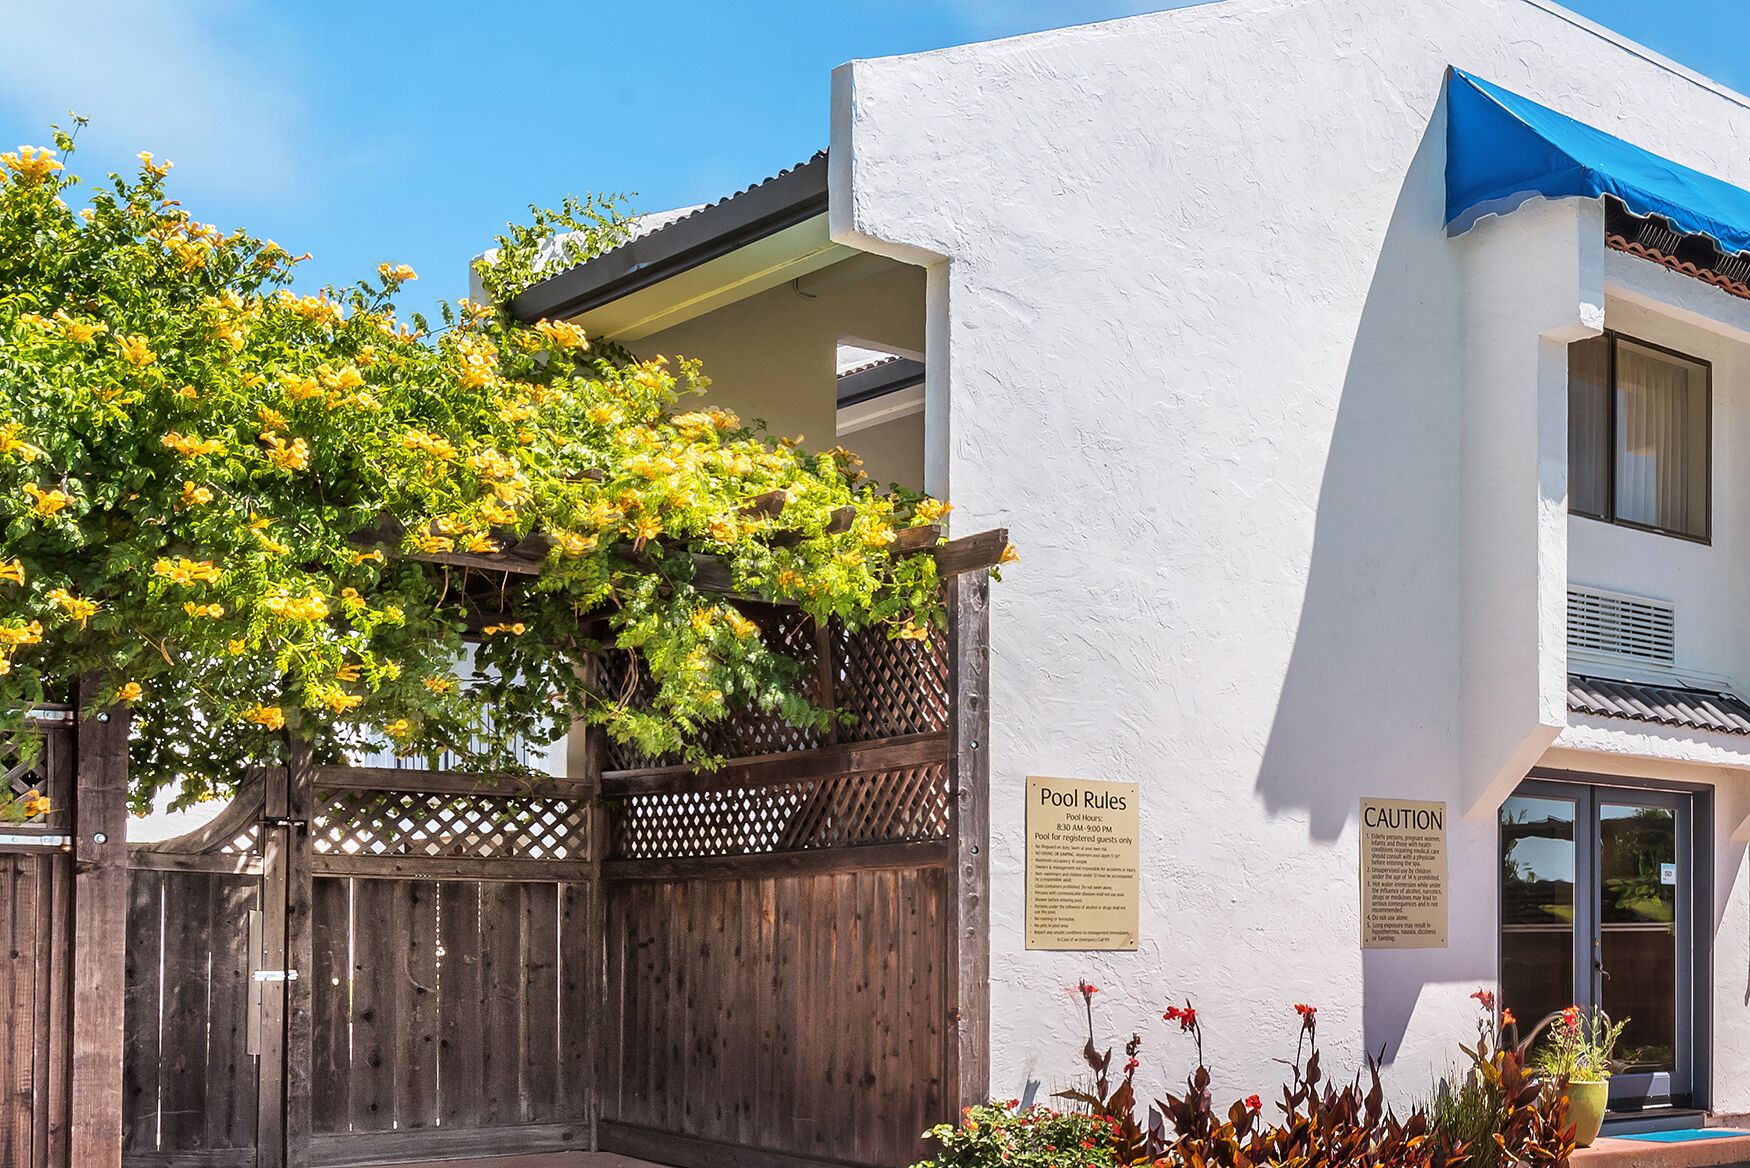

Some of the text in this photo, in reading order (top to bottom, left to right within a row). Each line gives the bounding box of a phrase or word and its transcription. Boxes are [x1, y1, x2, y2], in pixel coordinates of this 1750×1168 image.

[1041, 788, 1126, 810] Pool Rules
[1365, 807, 1442, 830] CAUTION
[1063, 834, 1095, 843] registered
[1097, 835, 1117, 844] guests
[1119, 837, 1132, 845] only
